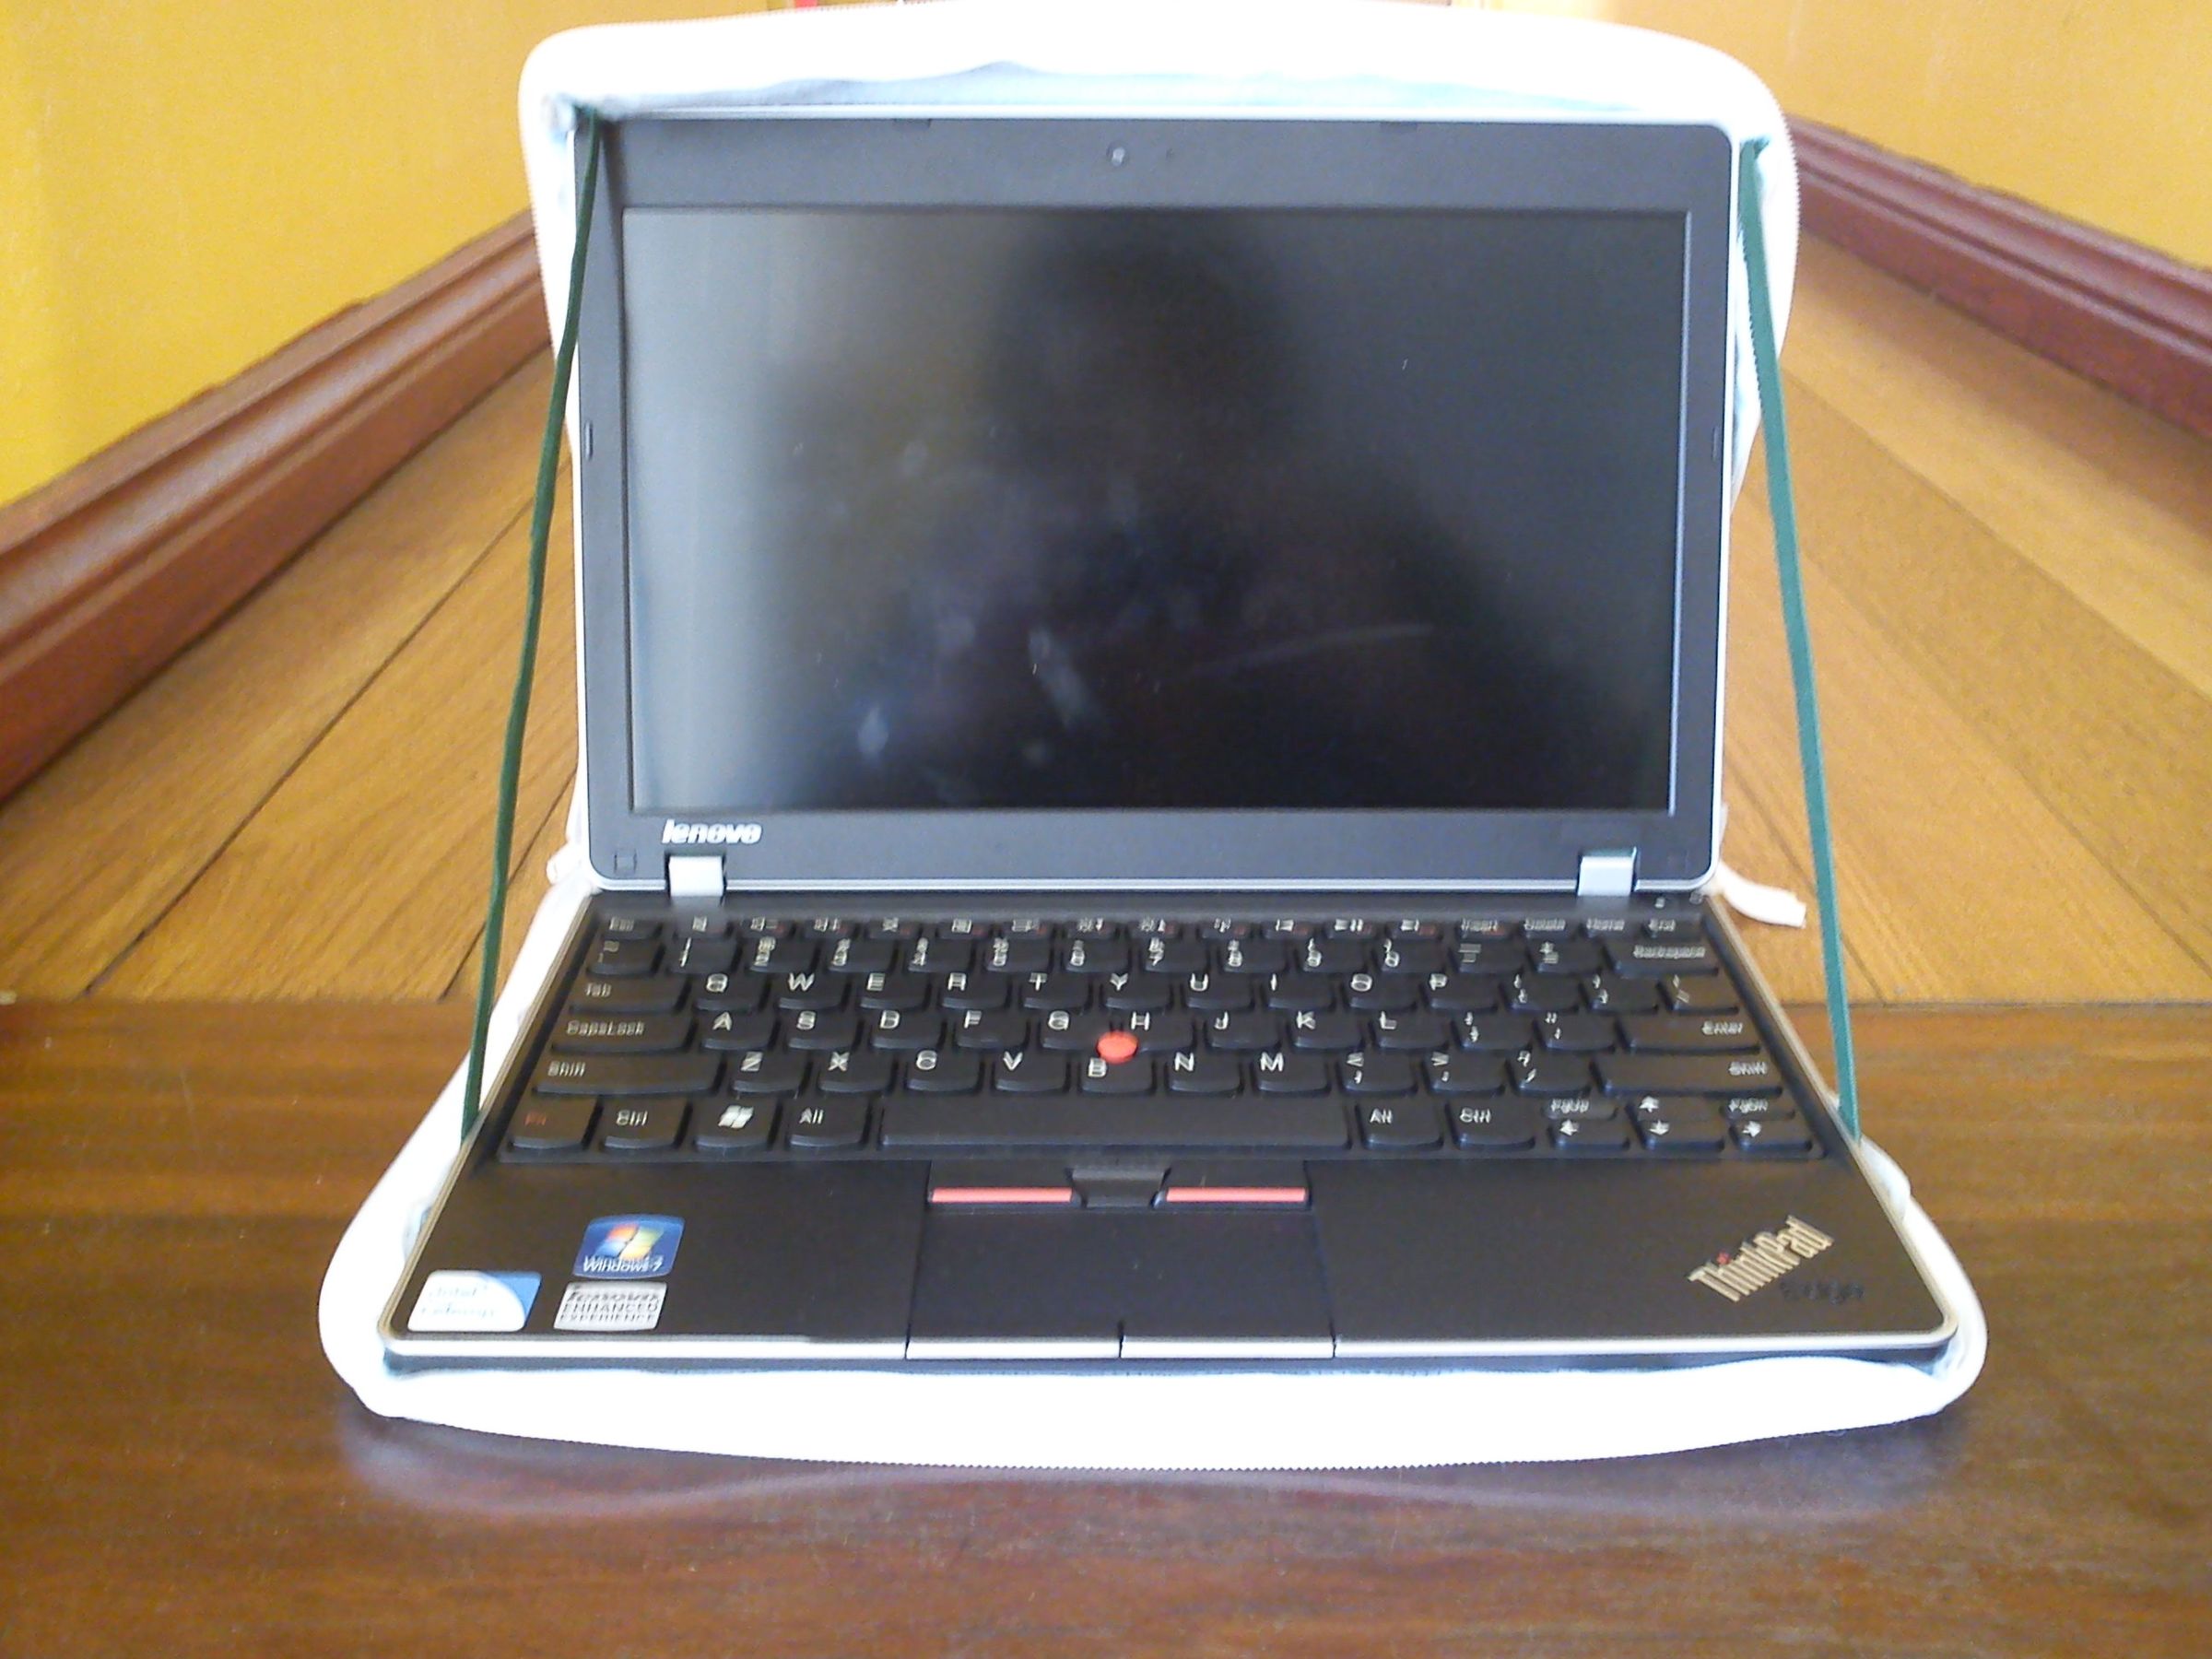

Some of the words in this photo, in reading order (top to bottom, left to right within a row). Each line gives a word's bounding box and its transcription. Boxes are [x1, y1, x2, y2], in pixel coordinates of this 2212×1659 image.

[662, 818, 763, 844] lenovo
[788, 972, 815, 992] W
[866, 972, 884, 991] E
[1029, 973, 1046, 991] T
[1110, 973, 1128, 991] Y
[1190, 972, 1209, 992] U
[1270, 973, 1277, 991] I
[712, 1012, 732, 1030] A
[879, 1010, 900, 1029] D
[1130, 1010, 1151, 1030] H
[1214, 1011, 1229, 1030] J
[1296, 1011, 1315, 1030] K
[1379, 1011, 1396, 1030] L
[740, 1053, 762, 1072] Z
[828, 1052, 849, 1072] X
[1003, 1052, 1023, 1071] V
[1174, 1052, 1194, 1072] N
[1260, 1053, 1284, 1072] M
[1688, 1215, 1834, 1302] ThinkPad
